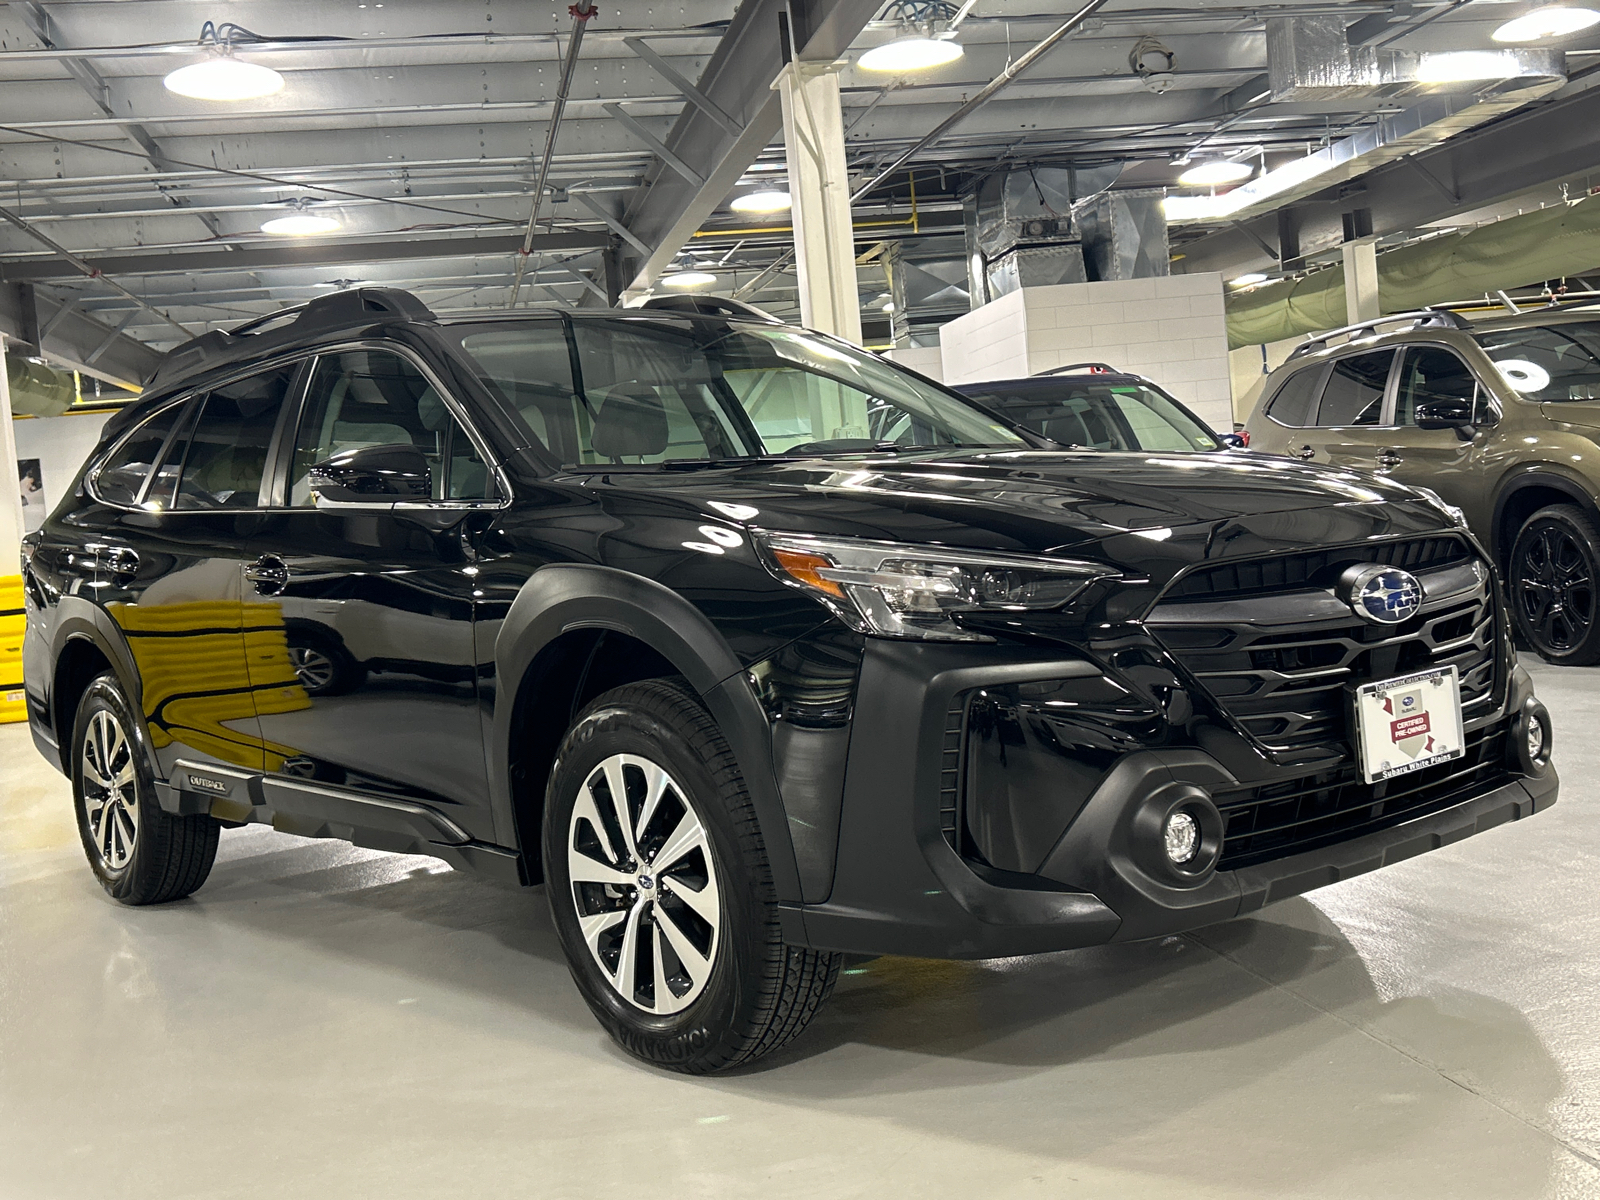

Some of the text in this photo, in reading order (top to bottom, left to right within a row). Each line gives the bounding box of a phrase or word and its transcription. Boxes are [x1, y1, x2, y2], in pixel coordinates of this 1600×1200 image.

[1395, 724, 1427, 738] PRE-OWNED
[1396, 717, 1424, 730] CERTIFIED
[1382, 754, 1451, 779] Subaru White Plains
[190, 776, 226, 792] OUTBACK
[619, 1023, 712, 1061] YOKOHAMA
